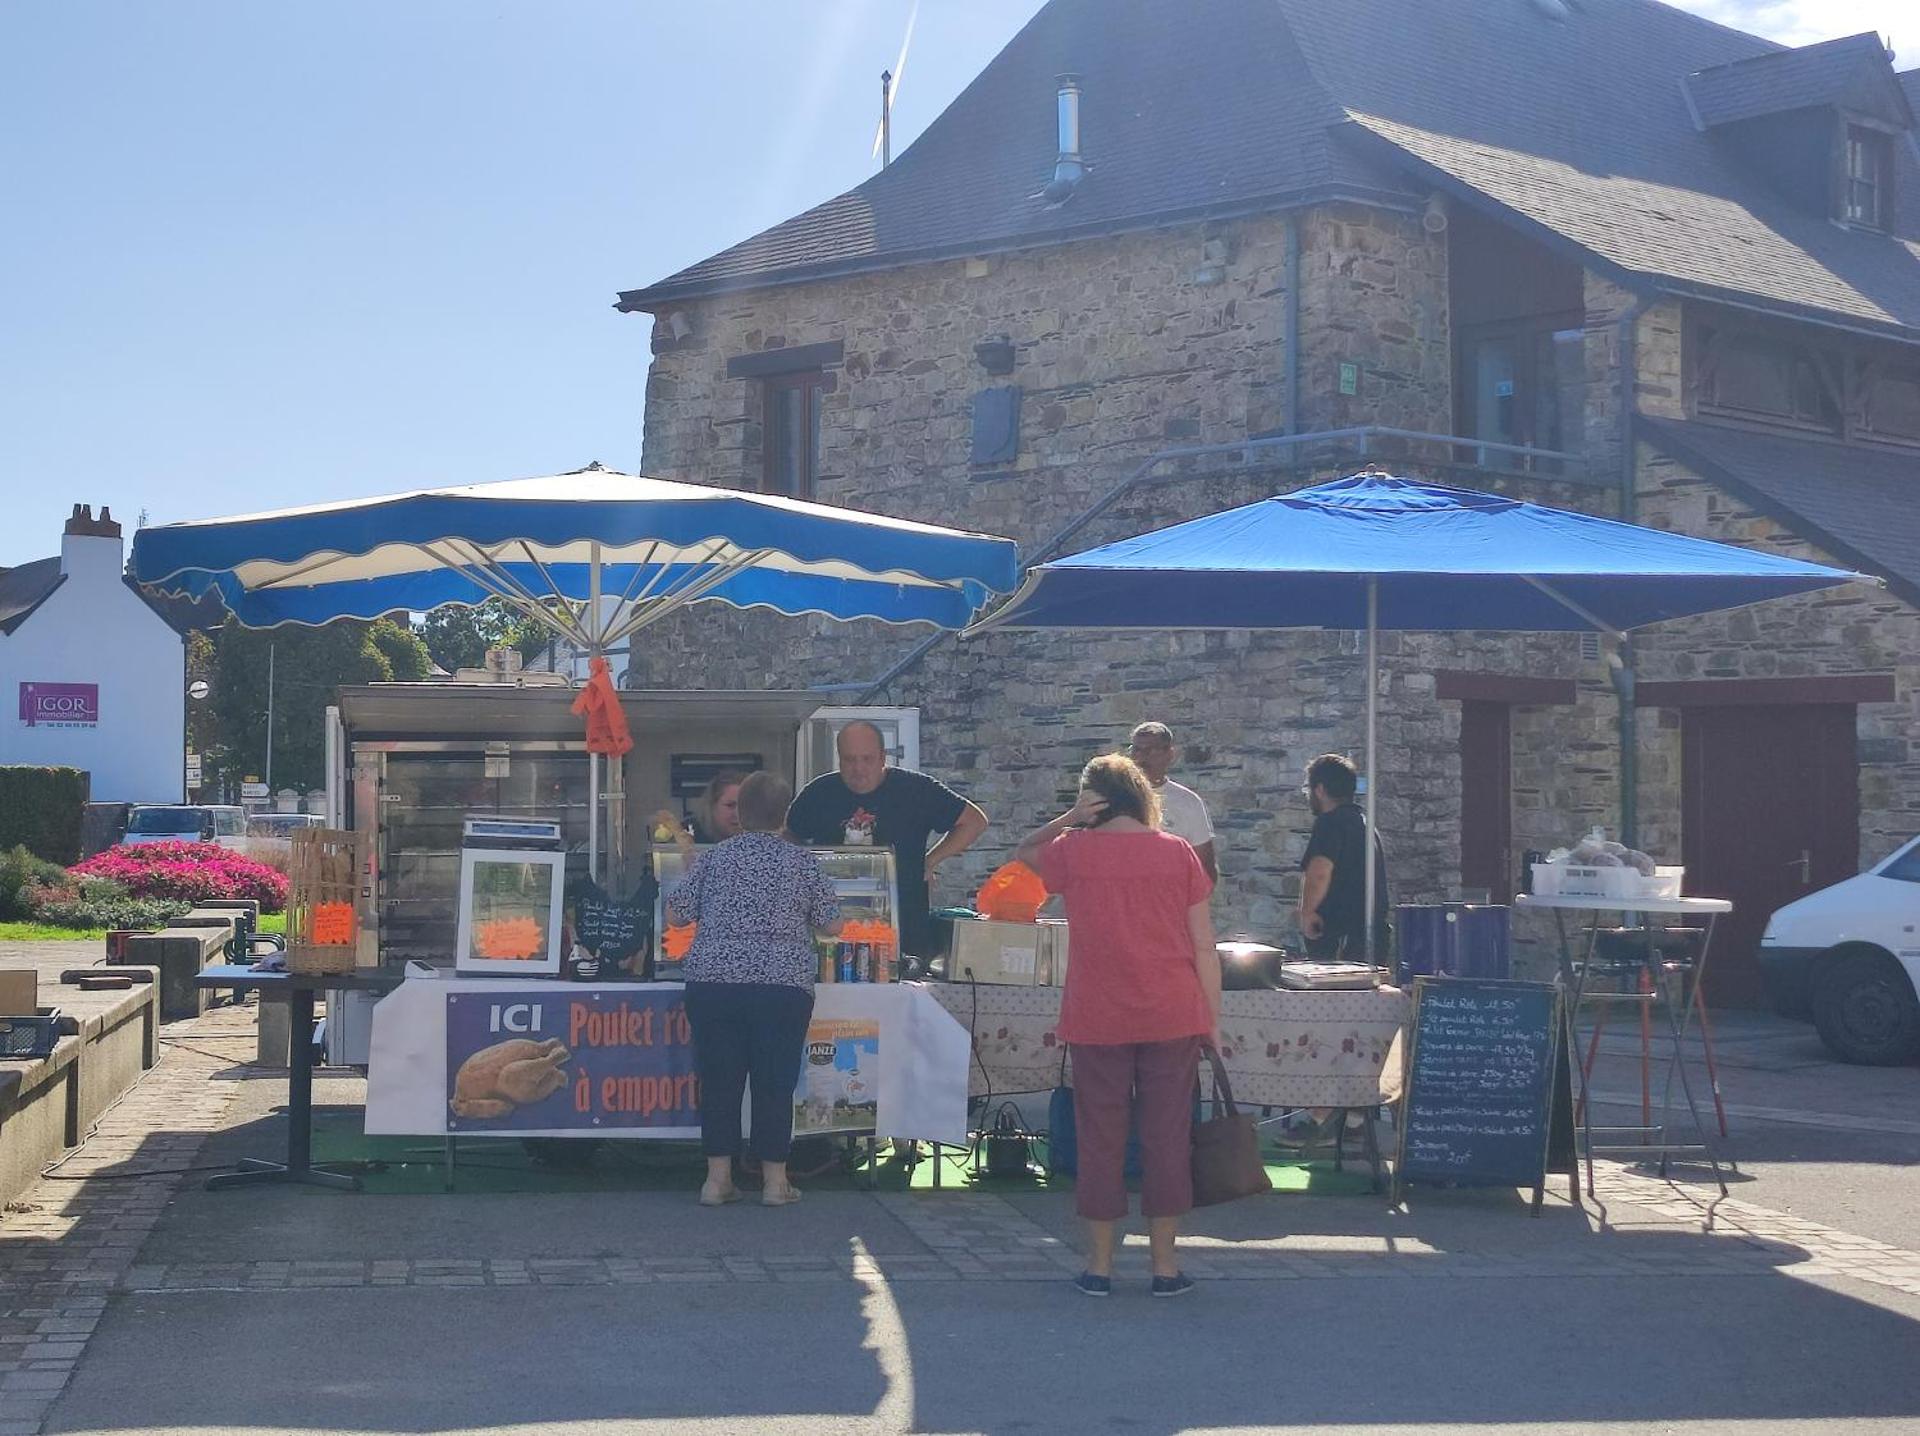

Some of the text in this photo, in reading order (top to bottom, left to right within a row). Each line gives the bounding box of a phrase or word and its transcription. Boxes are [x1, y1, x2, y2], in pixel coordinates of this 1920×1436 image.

[37, 696, 96, 713] IGOR
[489, 1004, 542, 1032] ICI
[570, 1002, 692, 1047] Poulet rô
[575, 1067, 700, 1117] à emport
